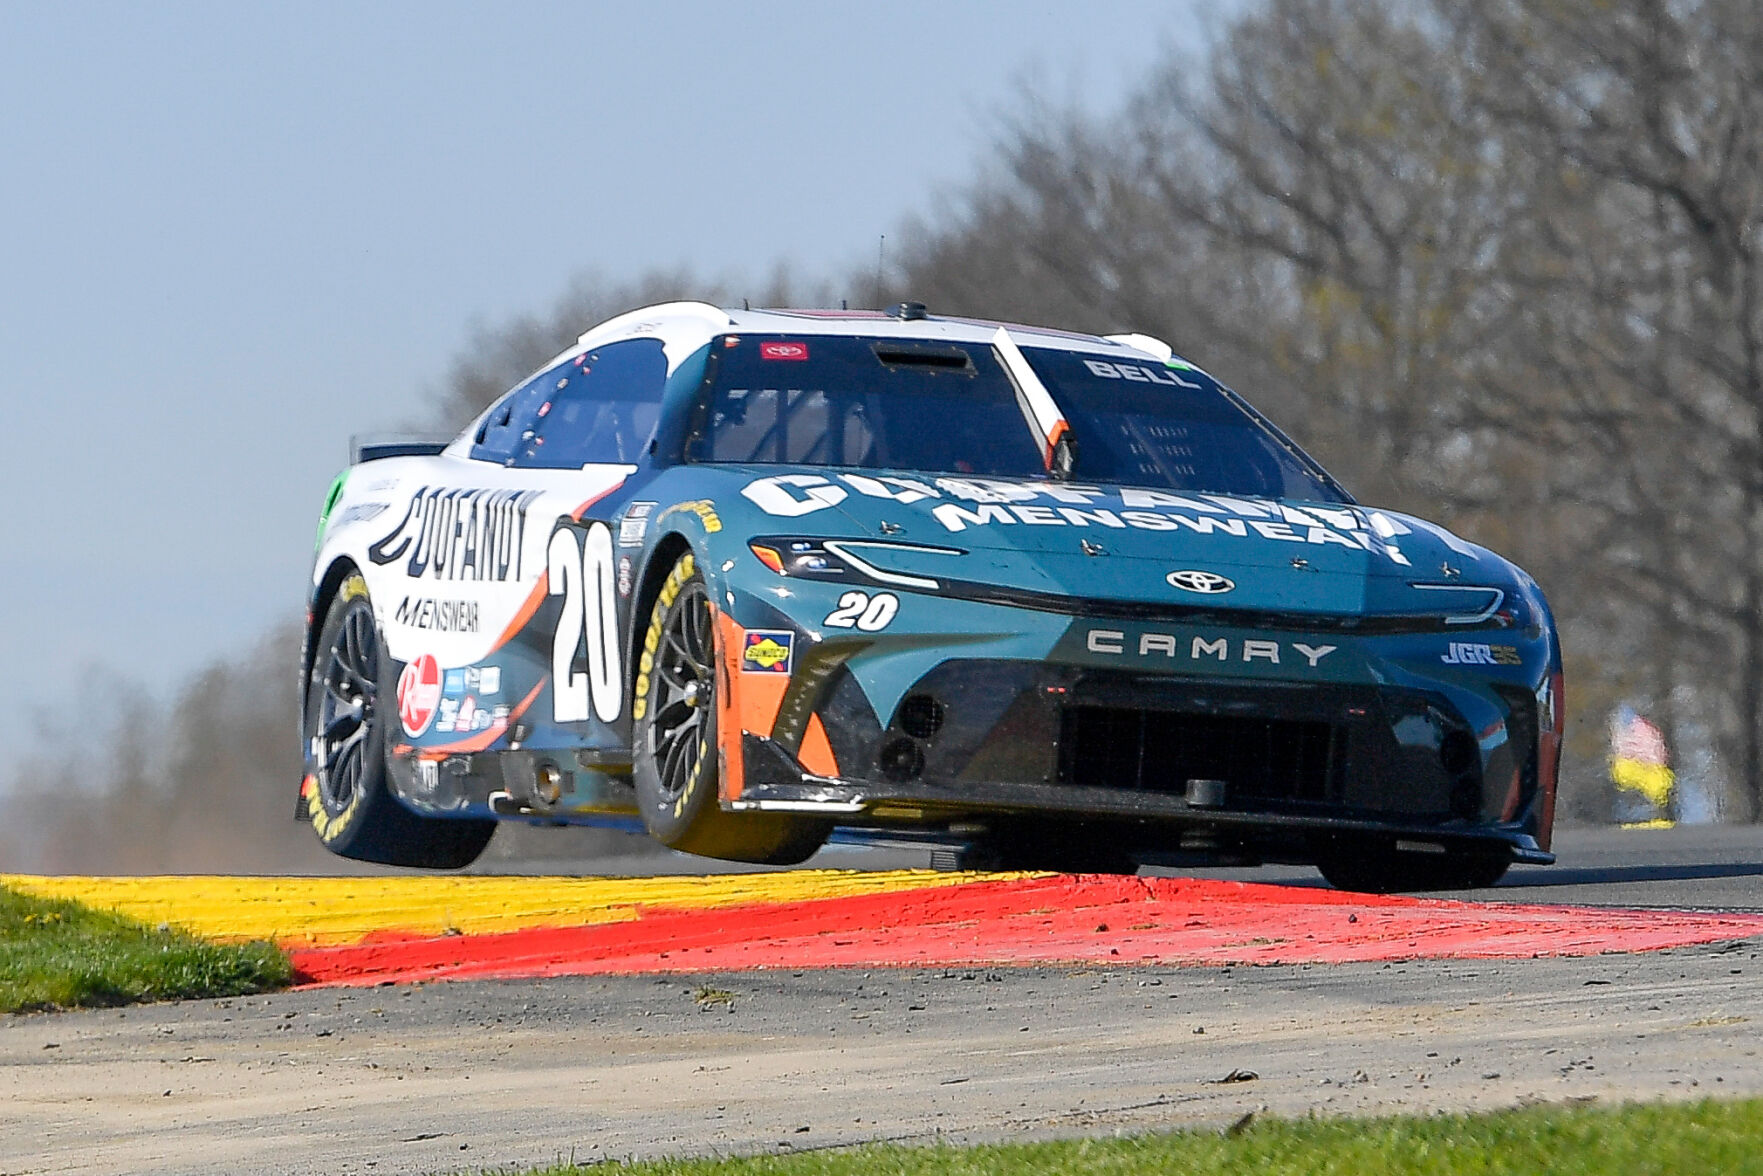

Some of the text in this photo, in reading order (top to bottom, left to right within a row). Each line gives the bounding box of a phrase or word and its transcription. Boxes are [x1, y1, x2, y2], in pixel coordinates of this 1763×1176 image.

[1082, 359, 1202, 390] BELL
[932, 503, 1412, 567] MENSWEAR
[395, 595, 480, 633] MENSWEAR
[547, 521, 622, 724] 20
[823, 590, 900, 632] 20
[1086, 629, 1338, 668] CAMRY
